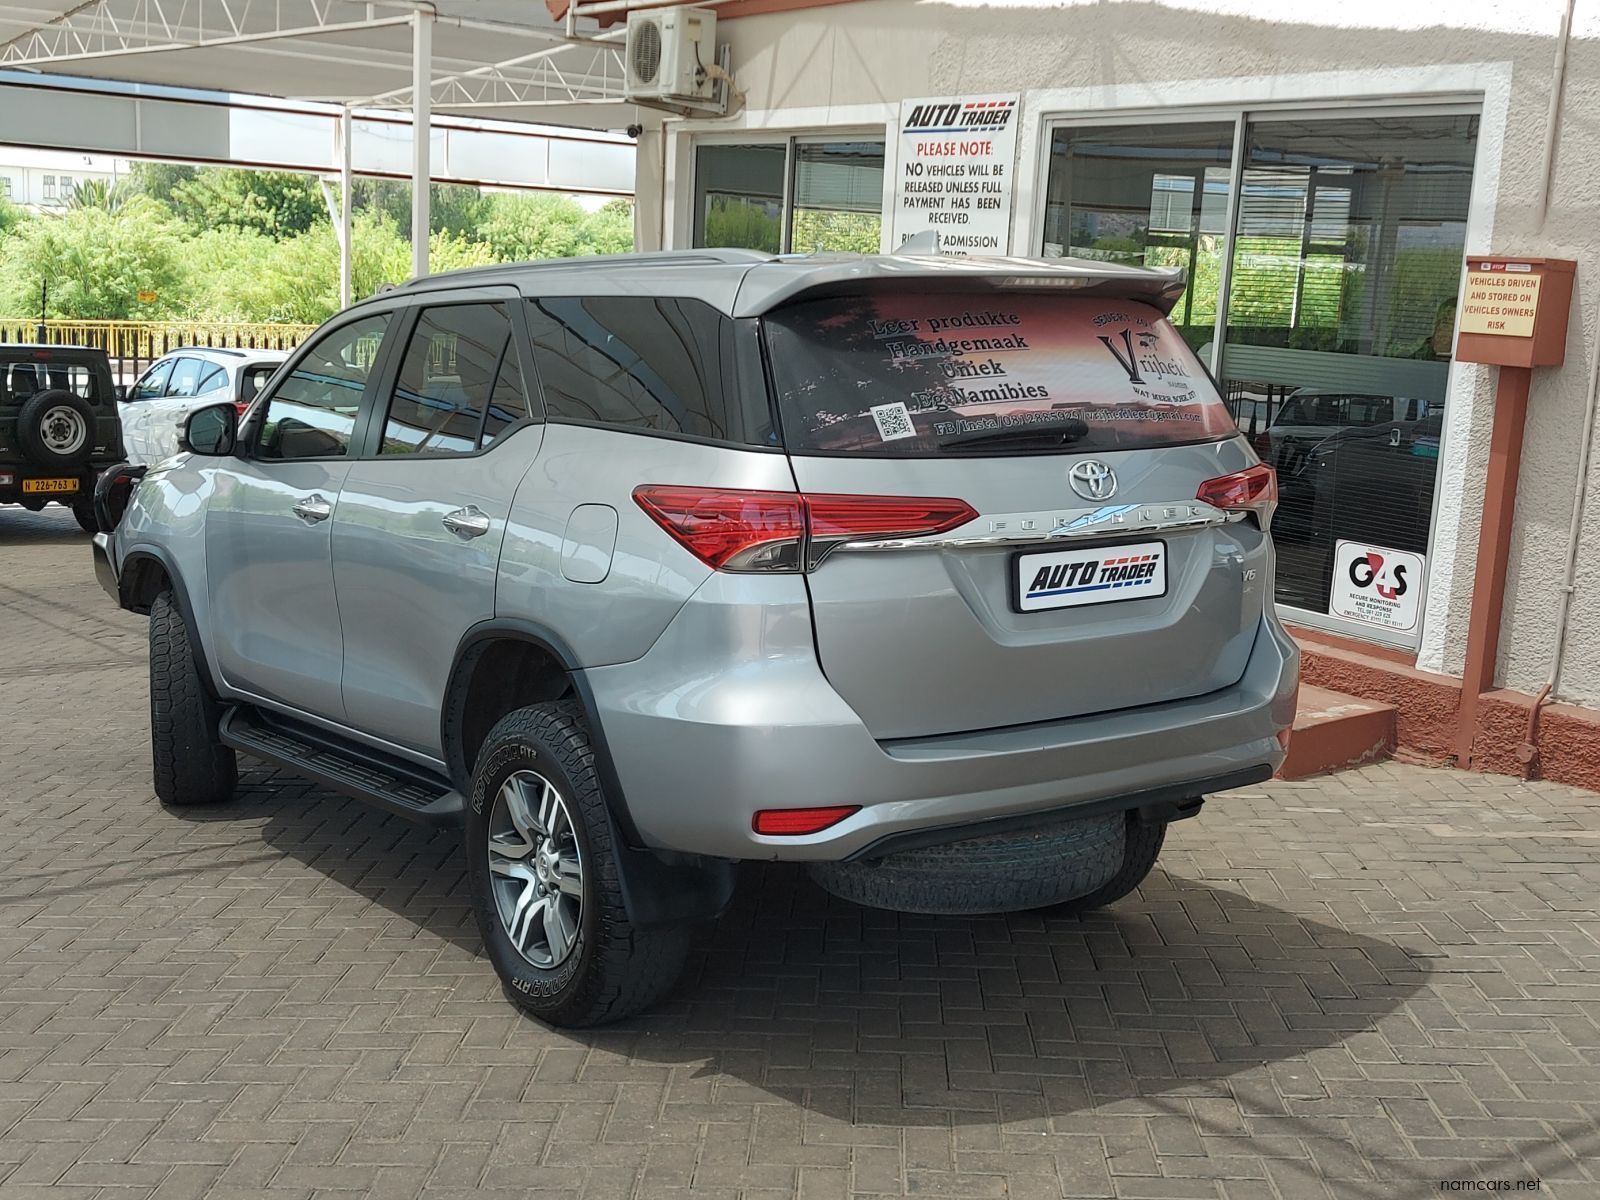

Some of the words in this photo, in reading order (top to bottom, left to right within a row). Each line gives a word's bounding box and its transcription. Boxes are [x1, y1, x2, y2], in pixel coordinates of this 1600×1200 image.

[905, 103, 962, 128] AUTO
[959, 109, 1012, 126] TRADER
[917, 142, 956, 156] PLEASE
[905, 162, 923, 177] NO
[926, 165, 965, 176] VEHICLES
[968, 165, 989, 176] WILL
[993, 164, 1004, 176] BE
[904, 181, 943, 193] RELEASED
[945, 182, 979, 193] UNLESS
[981, 182, 1002, 193] FULL
[903, 197, 945, 209] PAYMENT
[950, 197, 970, 209] HAS
[977, 197, 1001, 209] BEEN
[928, 212, 971, 225] RECEIVED.
[943, 234, 998, 248] ADMISSION
[1469, 277, 1506, 287] VEHICLES
[1507, 279, 1537, 288] DRIVEN
[1471, 291, 1486, 300] AND
[1488, 292, 1518, 302] STORED
[1519, 294, 1531, 303] ON
[1464, 305, 1500, 315] VEHICLES
[1502, 308, 1534, 317] OWNERS
[868, 319, 920, 336] Leer
[926, 311, 1021, 333] produkte
[1487, 321, 1506, 330] RISK
[886, 333, 1029, 359] Handgemaak
[937, 359, 1006, 378] Uniek
[950, 382, 1049, 405] Namibies
[25, 481, 31, 491] N
[35, 481, 68, 490] 226-763
[1028, 560, 1099, 592] AUTO
[1099, 561, 1157, 583] TRADER
[1349, 552, 1407, 600] G4S
[1366, 603, 1393, 613] RESPONSE
[1369, 597, 1401, 609] MONITORING
[472, 744, 521, 815] APTERRA
